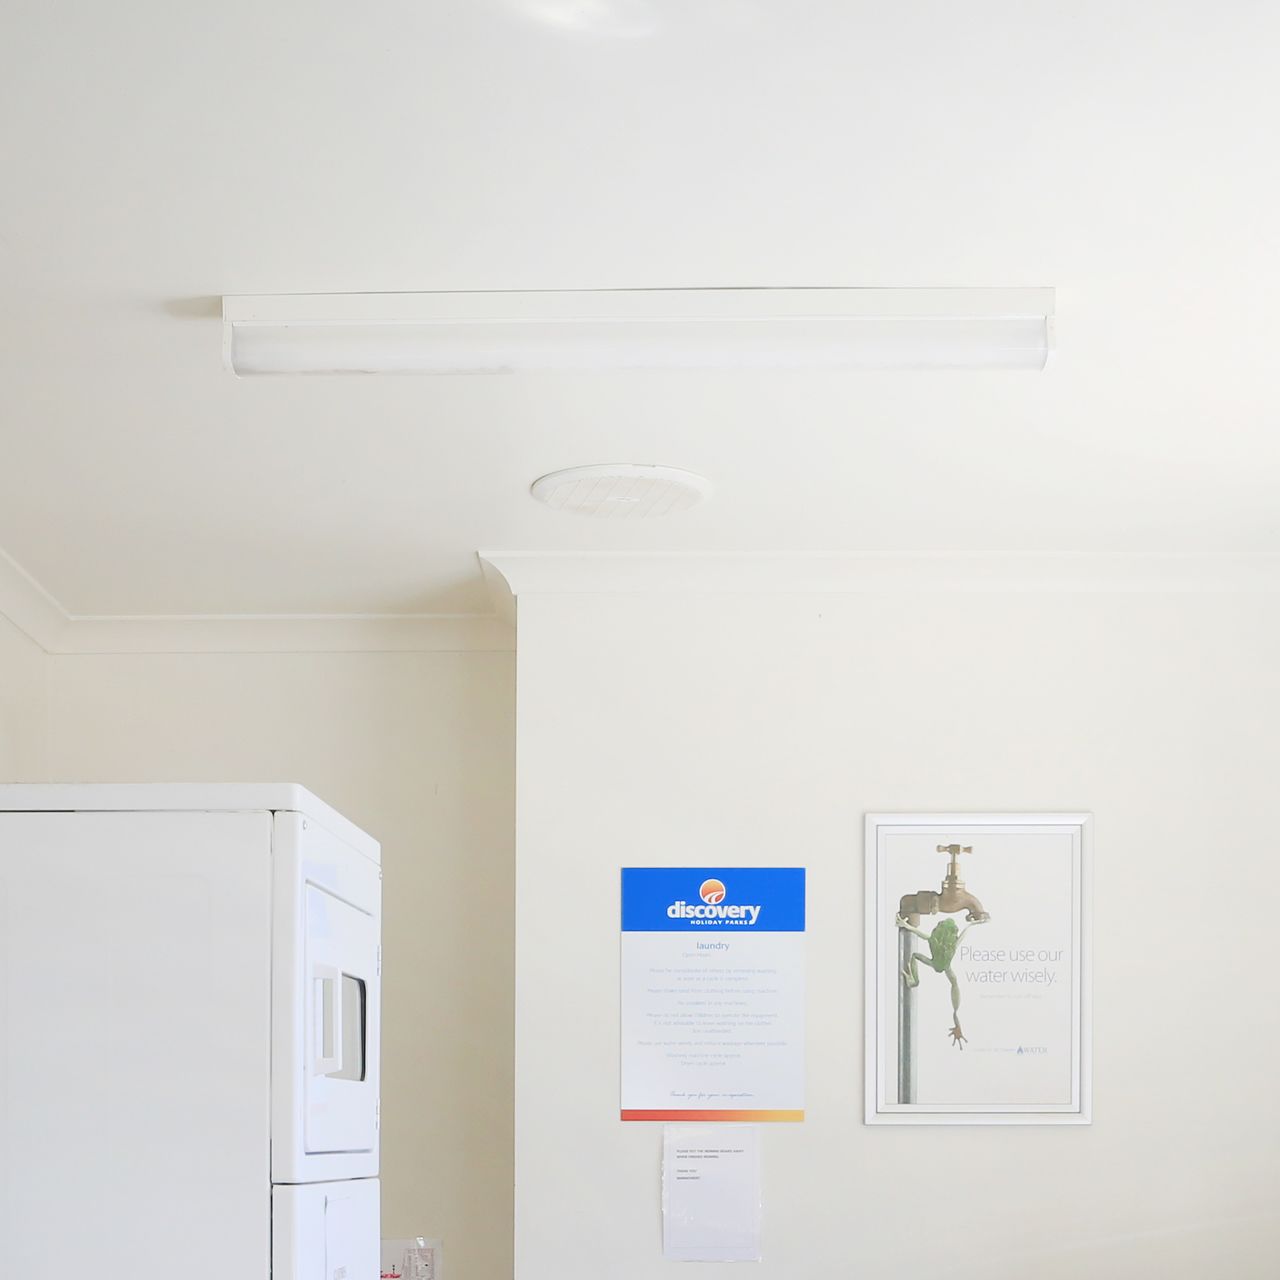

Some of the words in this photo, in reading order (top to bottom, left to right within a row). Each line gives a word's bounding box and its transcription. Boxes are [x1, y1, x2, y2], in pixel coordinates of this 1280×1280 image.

[667, 900, 761, 925] discovery
[696, 942, 730, 951] laundry
[960, 946, 1006, 962] Please
[1008, 950, 1034, 962] use
[1038, 950, 1063, 962] our
[966, 971, 1007, 984] water
[1011, 970, 1057, 987] wisely.
